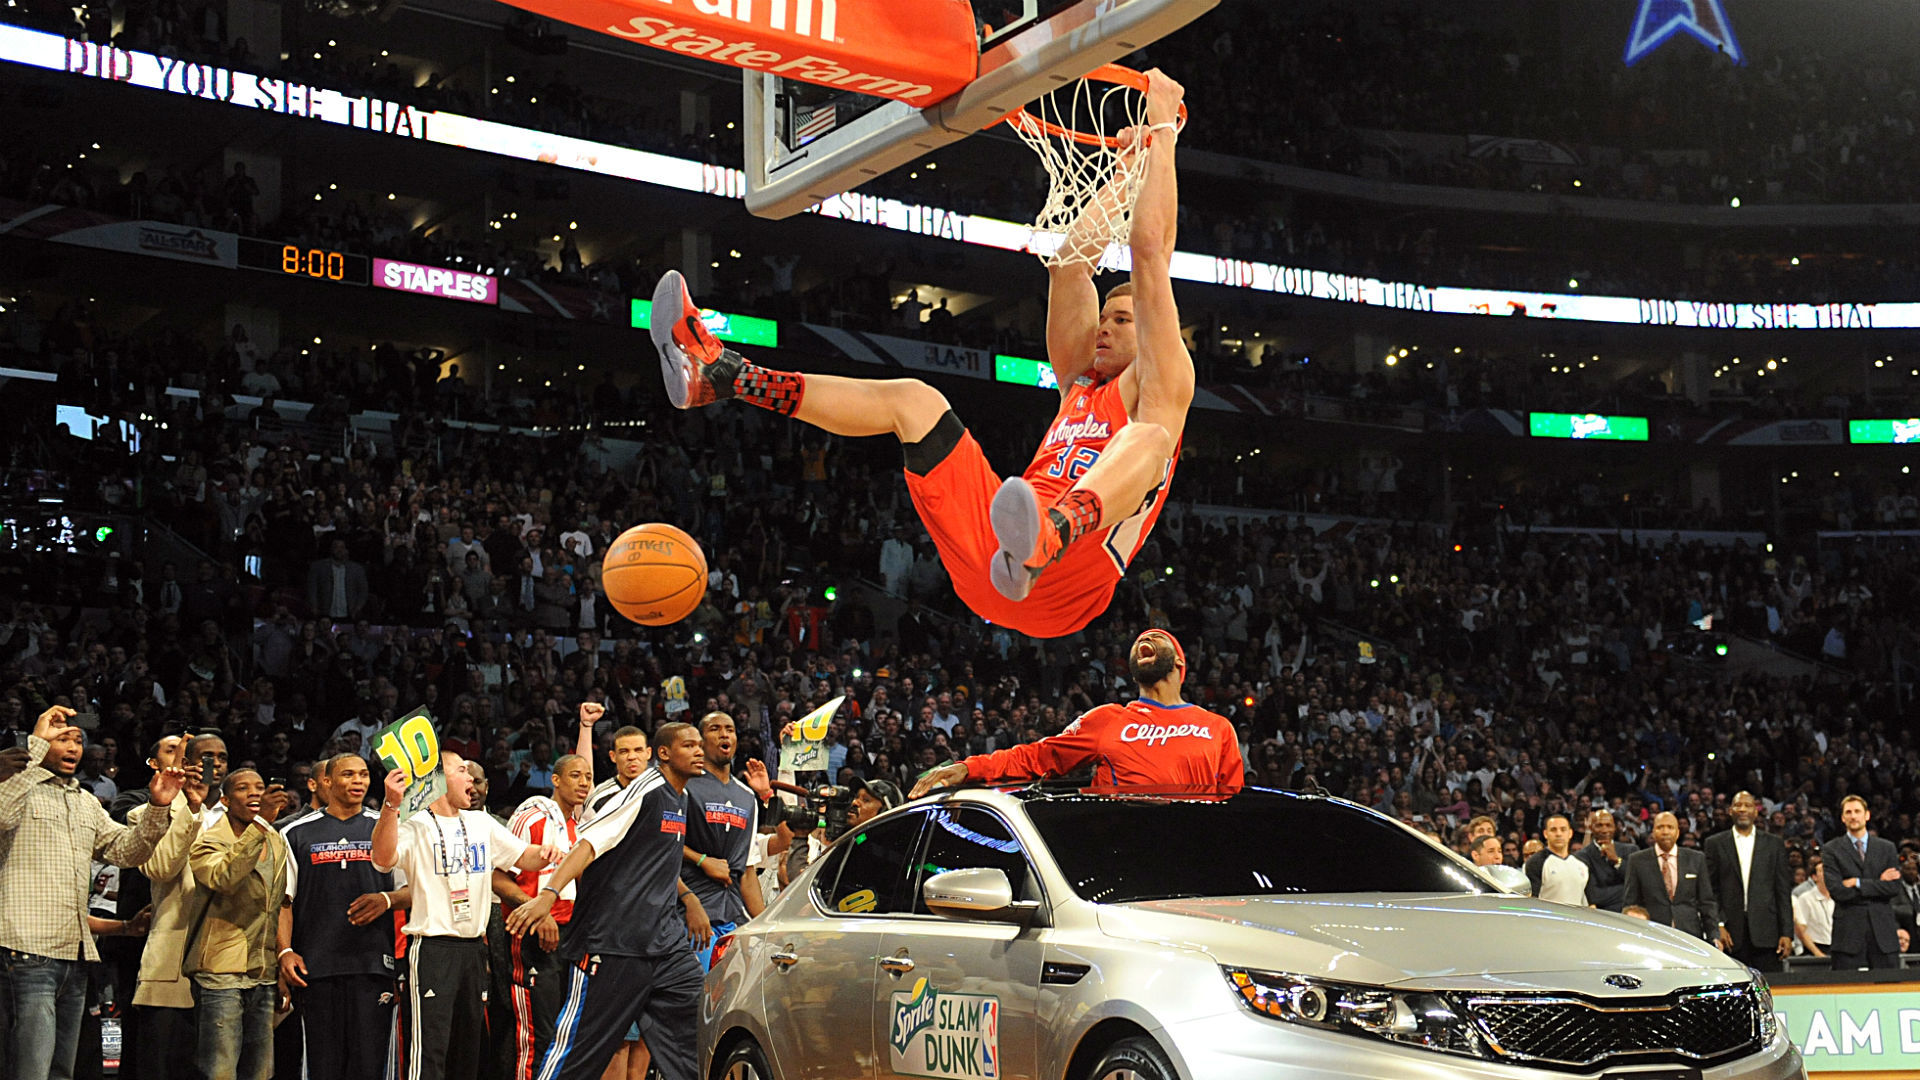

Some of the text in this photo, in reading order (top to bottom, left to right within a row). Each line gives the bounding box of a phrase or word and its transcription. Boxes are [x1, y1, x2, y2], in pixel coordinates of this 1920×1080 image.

[606, 16, 933, 100] State Farm
[65, 38, 435, 140] DID YOU SEE THAT
[839, 191, 971, 241] SEE THAT
[282, 245, 344, 280] 8:00
[383, 262, 488, 301] STAPLES
[1216, 256, 1438, 312] DID YOU SEE THAT
[1640, 299, 1876, 329] DID YOU SEE THAT
[1051, 413, 1112, 447] Angeles
[1047, 445, 1100, 480] 32
[612, 540, 675, 557] SPALD
[661, 675, 685, 700] 10
[375, 715, 440, 789] 10
[1120, 723, 1213, 747] Clippers
[794, 748, 818, 765] Sprite
[410, 782, 432, 810] Sprite
[310, 843, 357, 853] OKLAHOMA
[895, 994, 934, 1046] Sprite
[938, 999, 981, 1032] SLAM
[924, 1033, 981, 1076] DUNK
